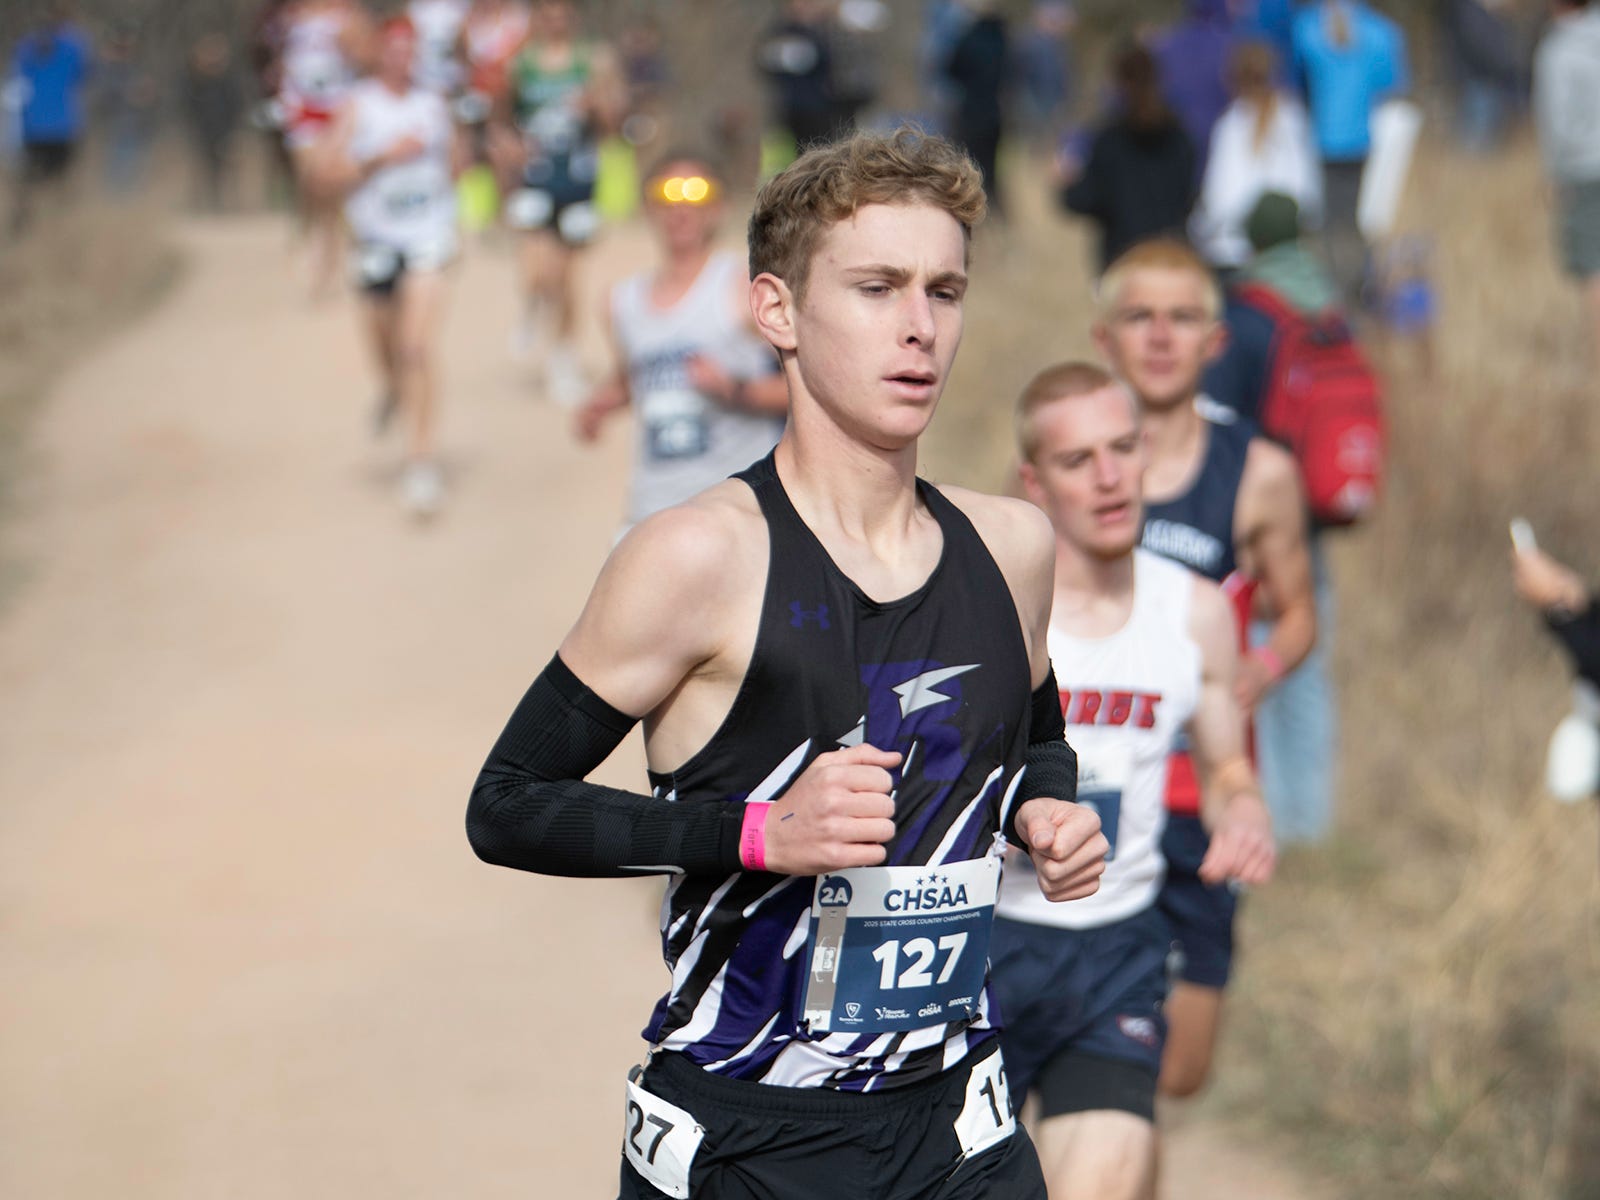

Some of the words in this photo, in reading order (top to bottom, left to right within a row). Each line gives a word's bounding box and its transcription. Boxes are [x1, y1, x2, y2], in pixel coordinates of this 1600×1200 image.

[820, 886, 849, 904] 2A
[884, 884, 968, 911] CHSAA
[917, 917, 942, 925] COUNTRY
[872, 932, 969, 990] 127
